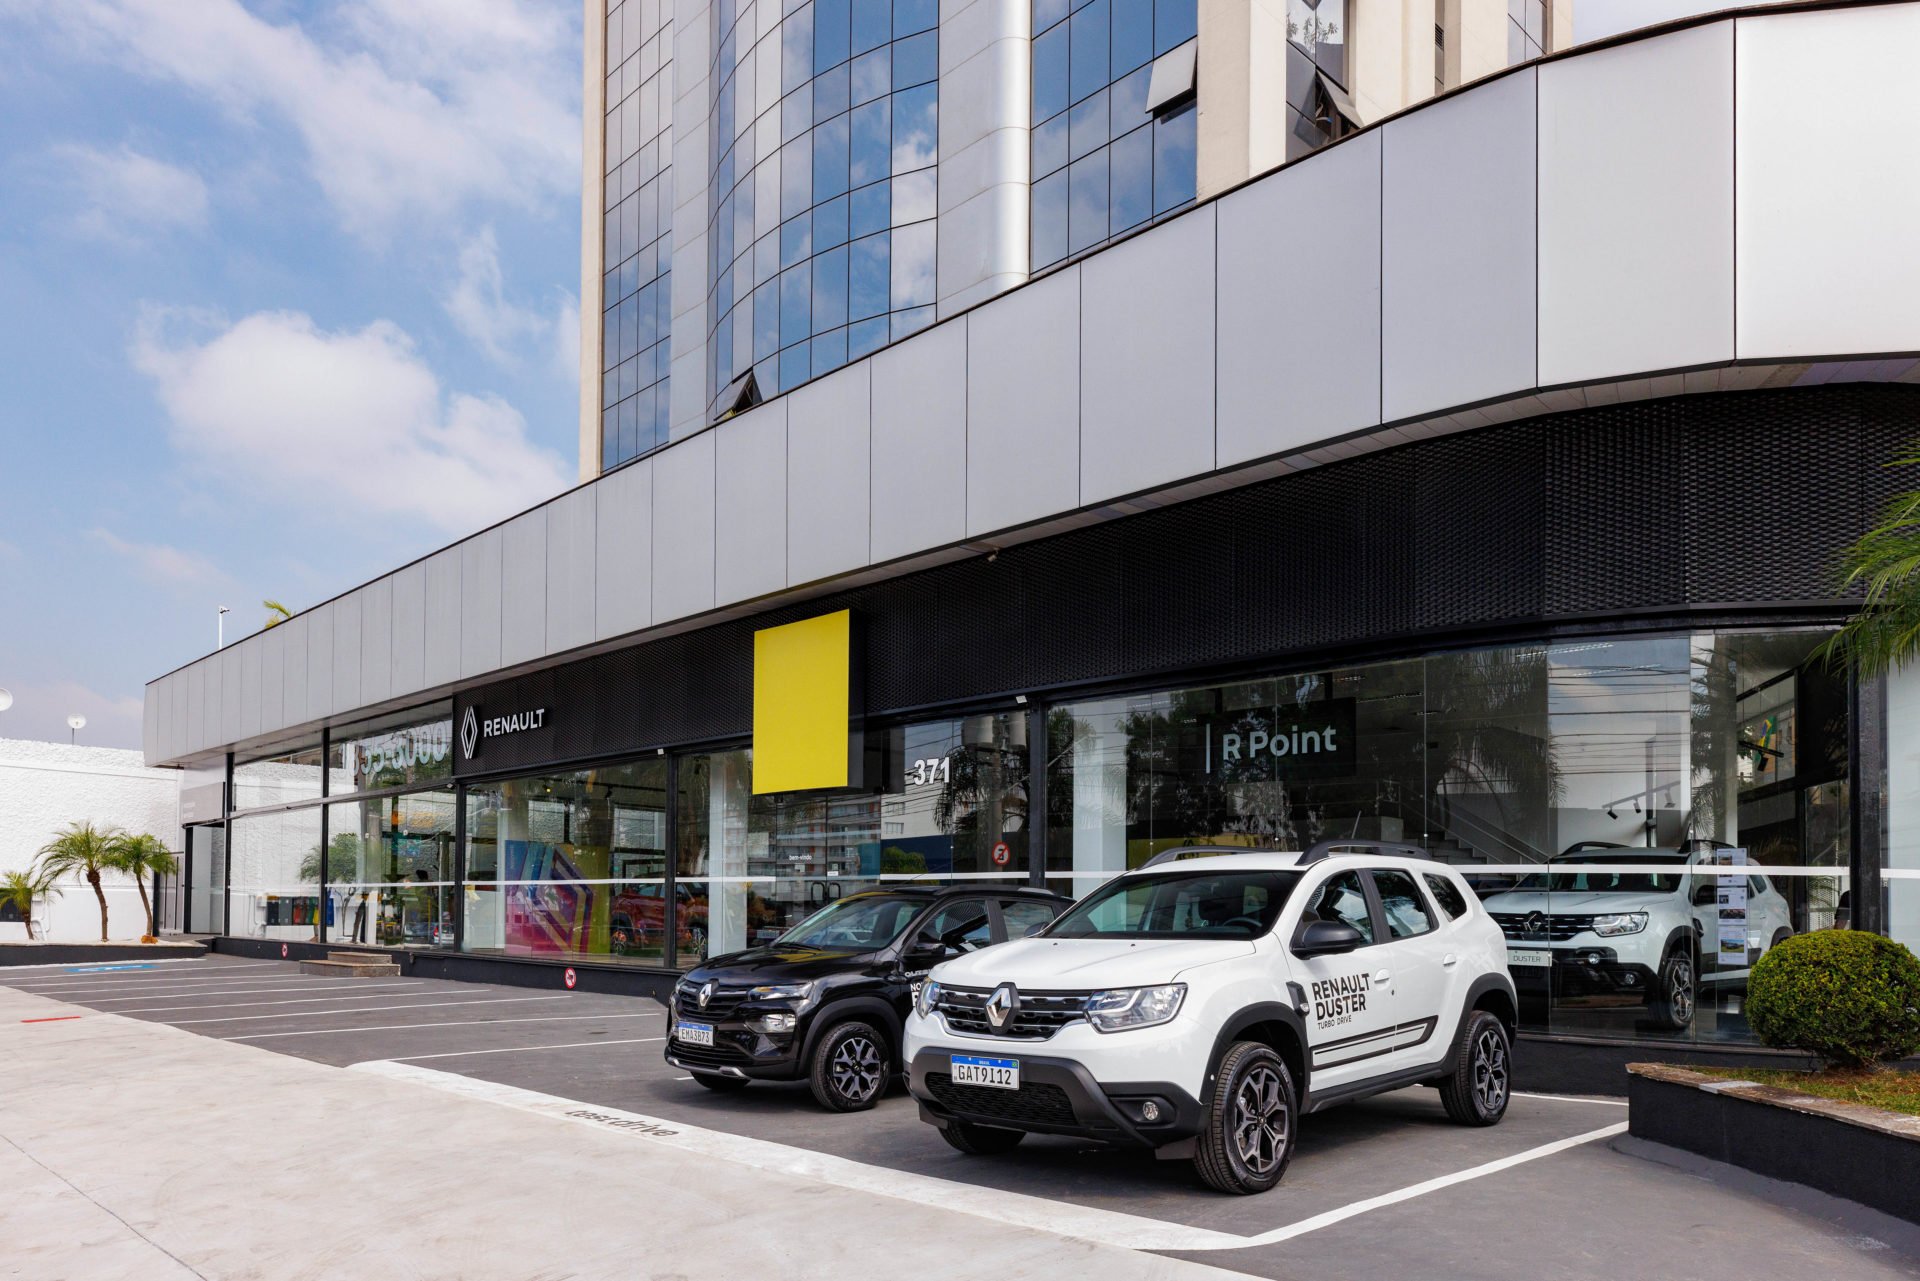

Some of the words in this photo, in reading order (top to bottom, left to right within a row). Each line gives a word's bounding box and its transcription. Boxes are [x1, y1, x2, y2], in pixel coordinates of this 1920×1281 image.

[483, 708, 545, 738] RENAULT
[1222, 733, 1242, 761] R
[1249, 725, 1337, 758] Point
[913, 756, 950, 786] 371
[1513, 955, 1541, 963] DUSTER
[1311, 973, 1370, 1001] RENAULT
[1315, 993, 1367, 1021] DUSTER
[1317, 1019, 1336, 1030] TURBO
[1336, 1014, 1352, 1026] DRIVE
[564, 1110, 621, 1122] test
[607, 1120, 680, 1137] drive
